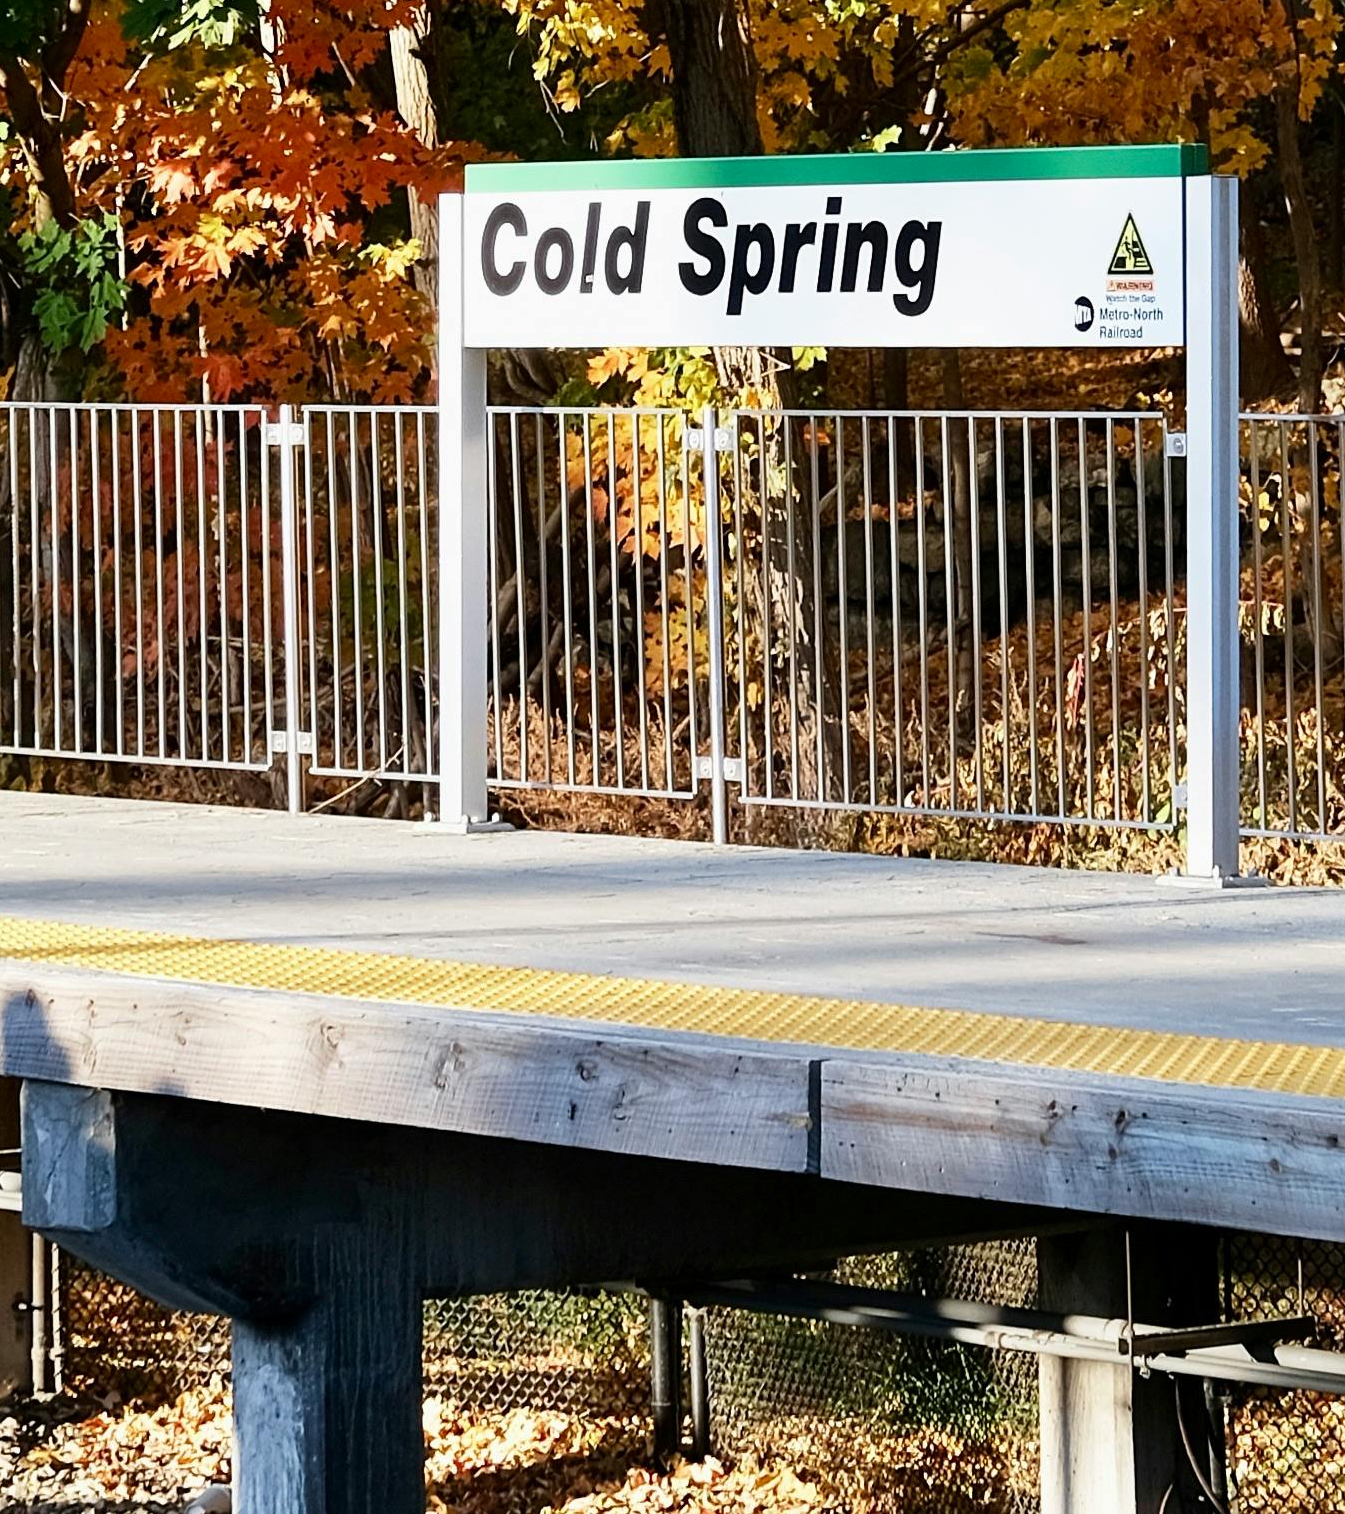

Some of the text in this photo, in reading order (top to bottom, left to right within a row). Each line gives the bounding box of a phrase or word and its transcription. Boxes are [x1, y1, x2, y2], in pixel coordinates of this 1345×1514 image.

[481, 197, 943, 317] Cold Spring
[1099, 308, 1164, 321] Metro-North
[1099, 326, 1144, 339] Railroad
